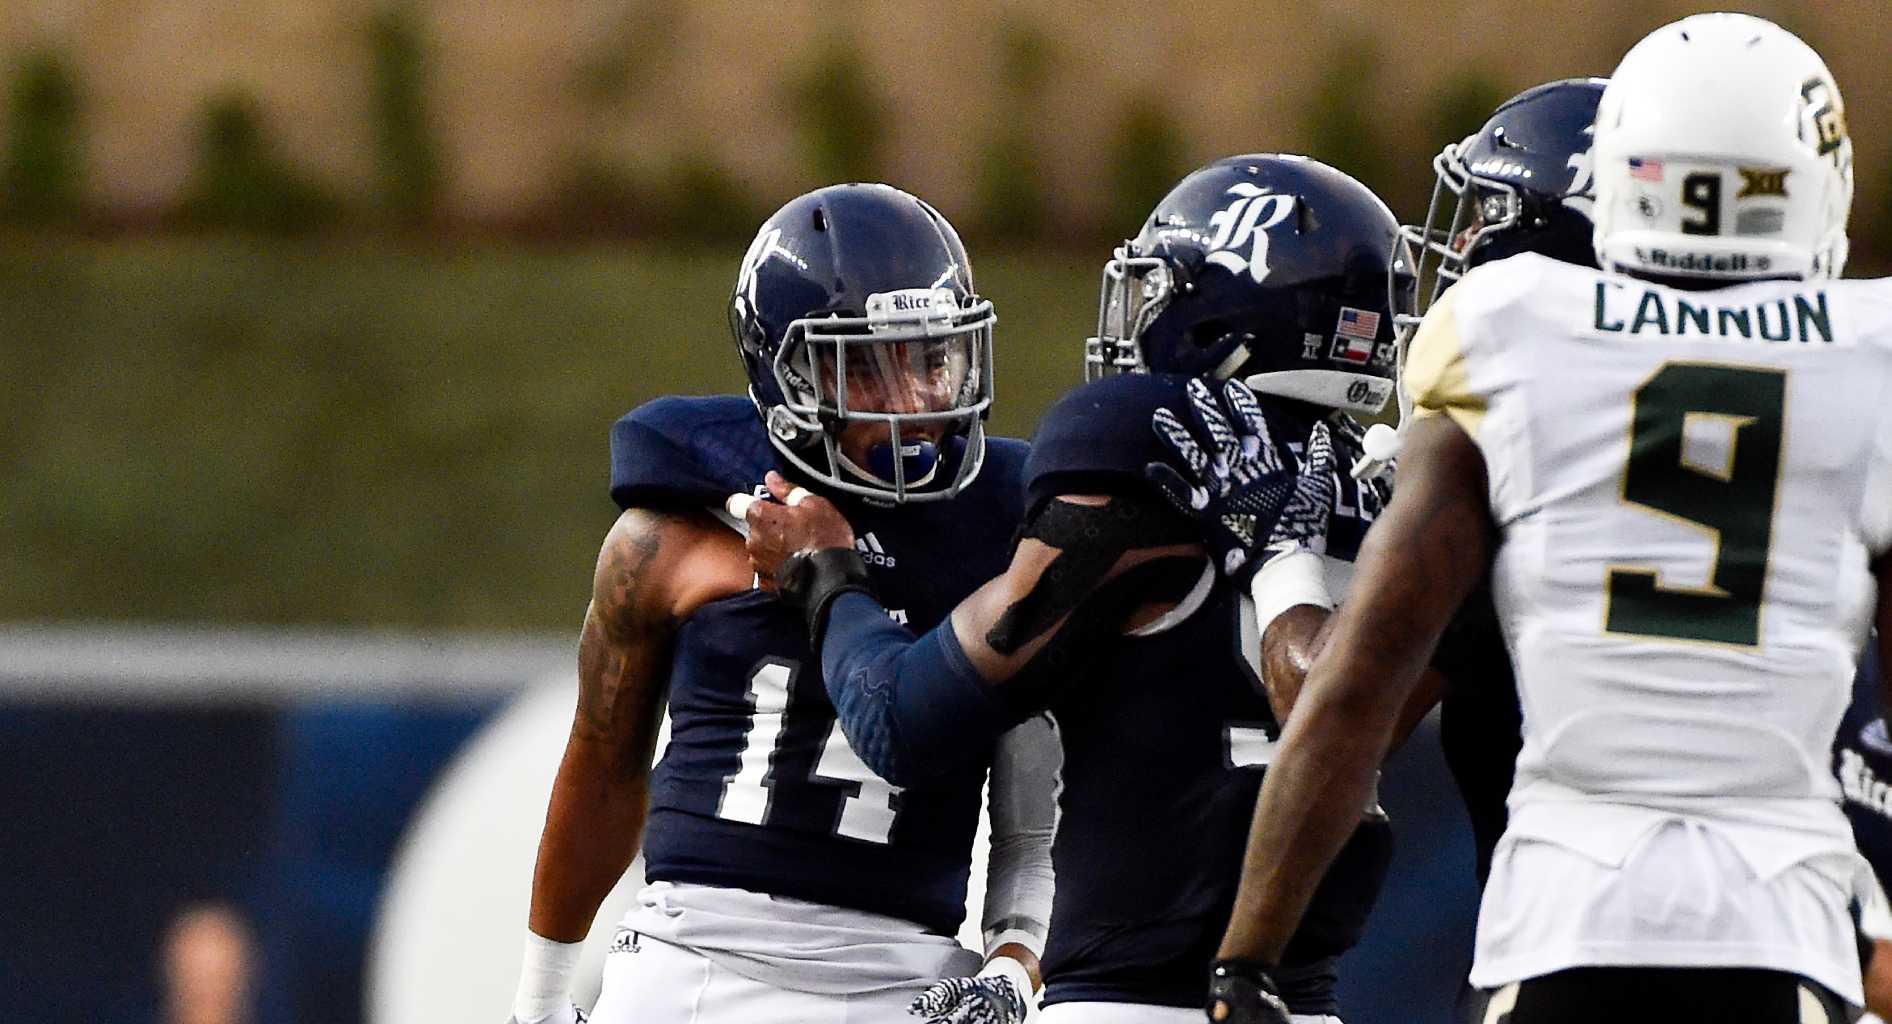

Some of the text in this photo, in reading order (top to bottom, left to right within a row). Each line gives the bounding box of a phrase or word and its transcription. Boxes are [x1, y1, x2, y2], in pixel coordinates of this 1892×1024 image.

[1680, 171, 1722, 236] 9
[892, 294, 931, 311] Rice
[1594, 280, 1834, 342] CANNON
[1604, 359, 1792, 653] 9
[863, 550, 896, 568] das
[713, 654, 908, 847] 14
